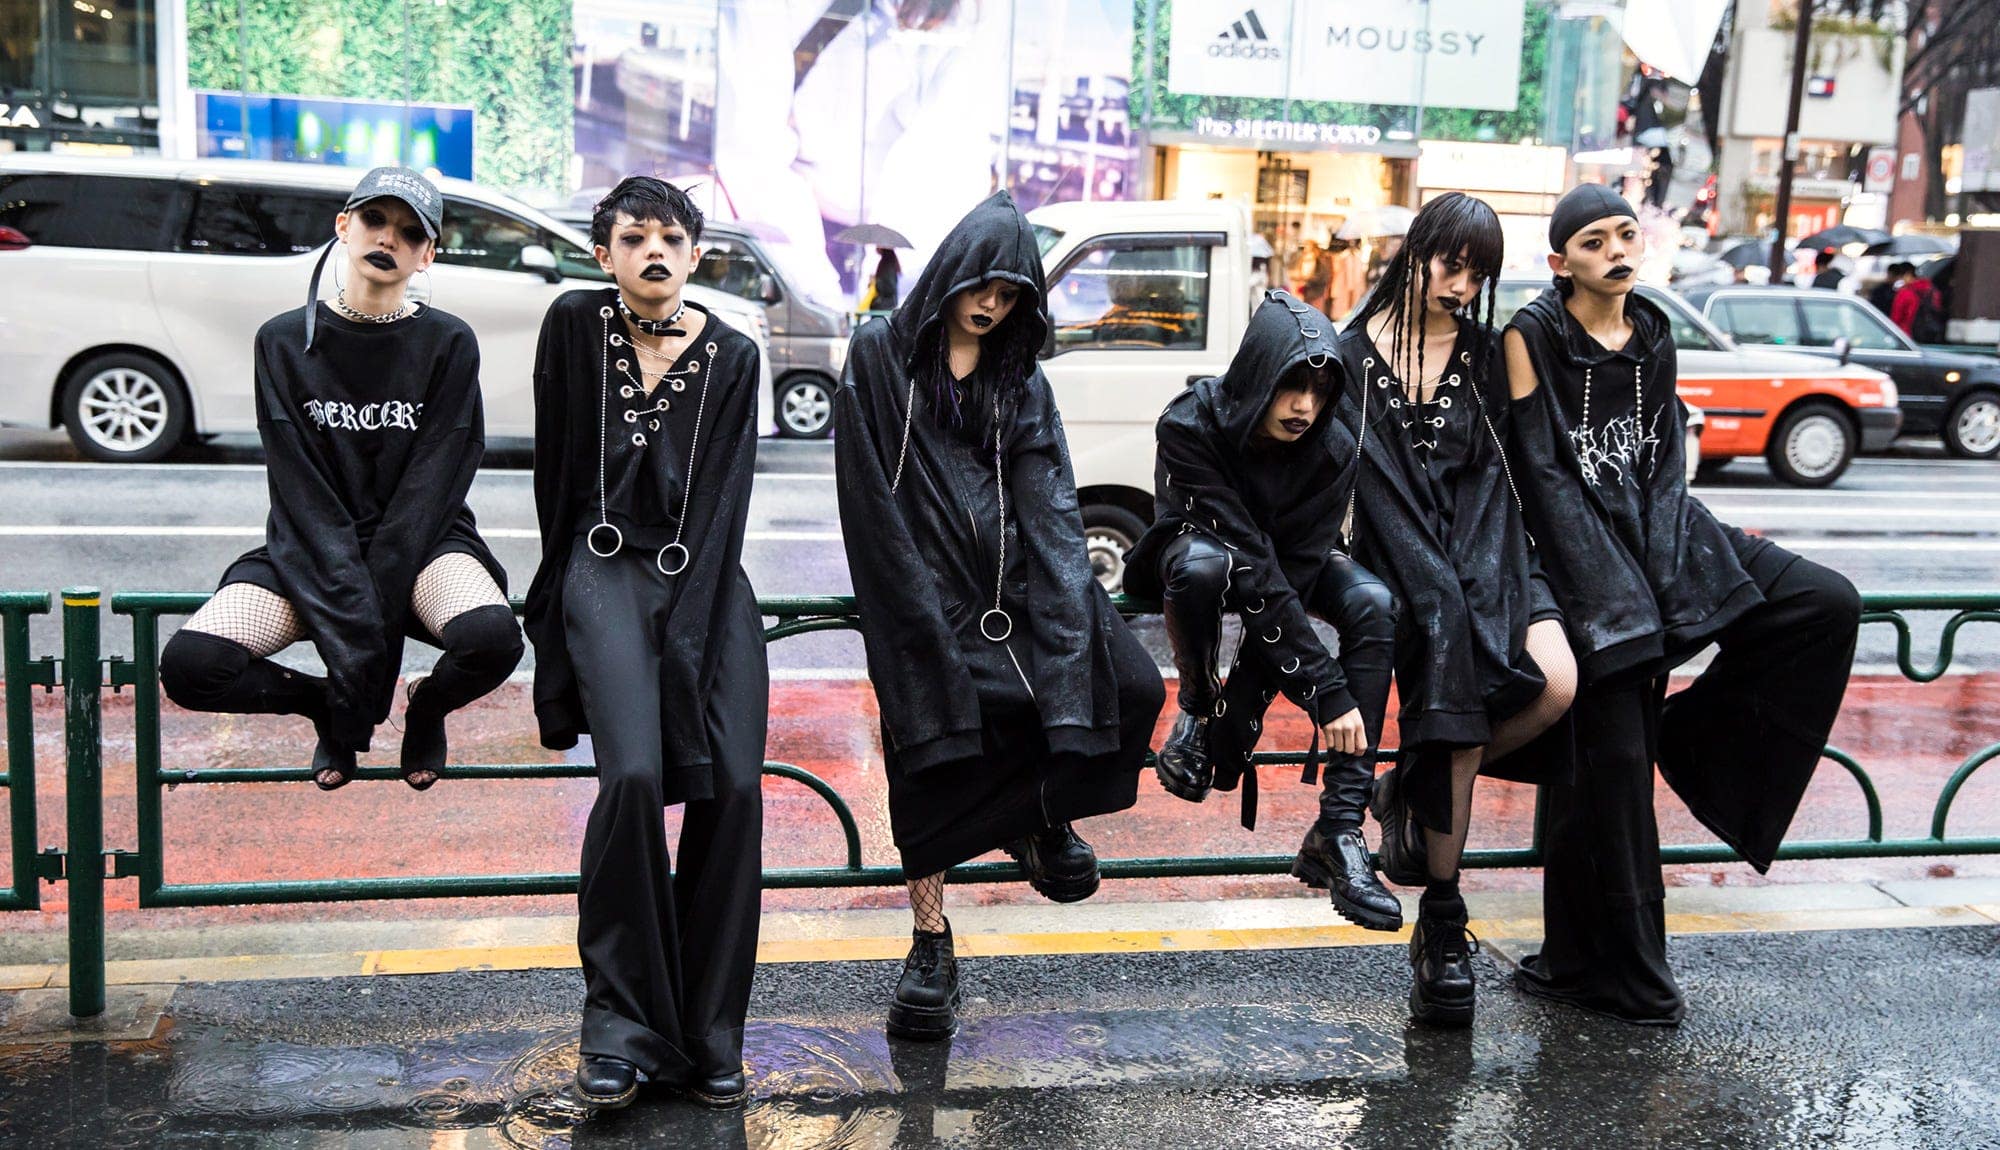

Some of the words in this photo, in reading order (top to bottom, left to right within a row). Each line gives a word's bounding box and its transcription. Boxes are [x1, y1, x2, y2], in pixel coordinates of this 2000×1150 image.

[1207, 42, 1281, 60] adidas
[1326, 25, 1485, 57] MOUSSY
[1318, 124, 1381, 145] TOKYO
